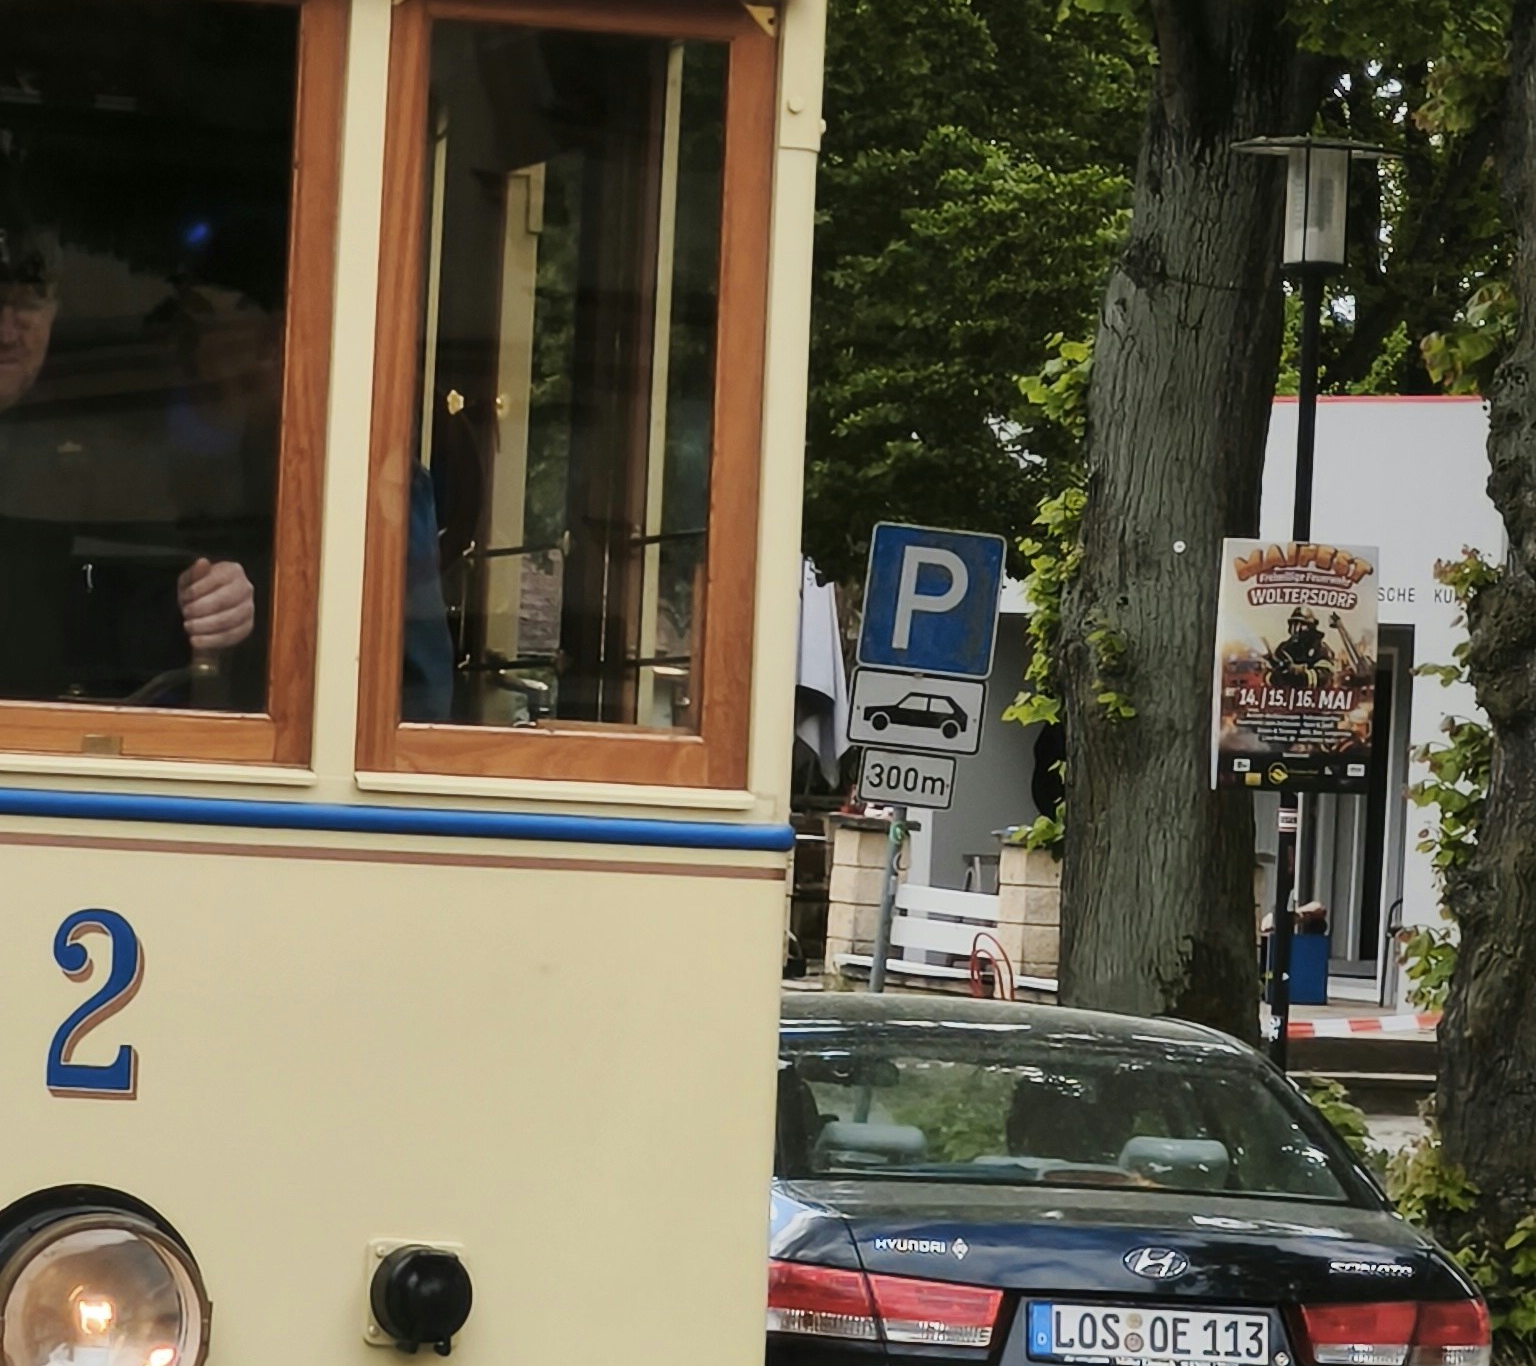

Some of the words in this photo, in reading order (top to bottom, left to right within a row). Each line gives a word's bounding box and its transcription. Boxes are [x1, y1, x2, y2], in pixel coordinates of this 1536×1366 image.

[1233, 541, 1374, 584] MAIFEST
[891, 544, 969, 650] P
[1250, 588, 1357, 609] WOLTERSDORF
[1376, 586, 1416, 603] SCHE
[1434, 588, 1458, 604] KU
[1318, 690, 1353, 710] MAI
[45, 907, 146, 1102] 2
[875, 1238, 946, 1253] HYUNDAI
[1054, 1310, 1120, 1350] LOS
[1149, 1315, 1192, 1355] OE
[1202, 1319, 1265, 1359] 113
